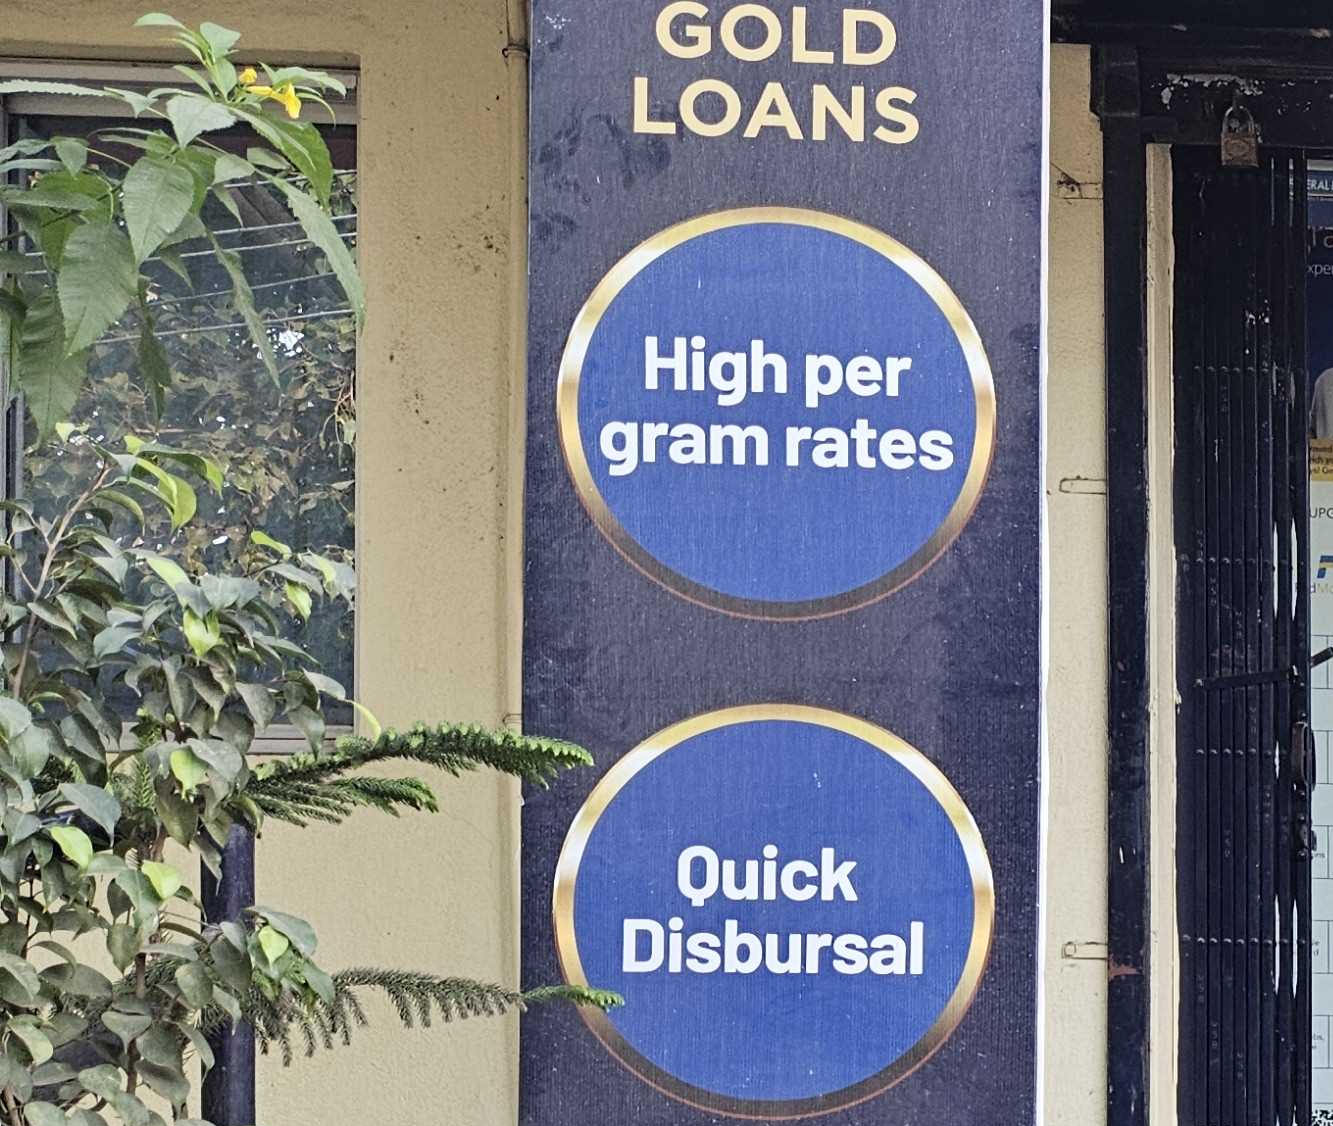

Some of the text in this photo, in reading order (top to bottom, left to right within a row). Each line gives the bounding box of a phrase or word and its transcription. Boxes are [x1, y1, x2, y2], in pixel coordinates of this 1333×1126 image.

[655, 0, 898, 66] GOLD
[632, 77, 920, 144] LOANS
[644, 335, 913, 407] High per
[599, 418, 954, 476] gram rates
[677, 844, 859, 907] Quick
[621, 917, 925, 976] Disbursal
